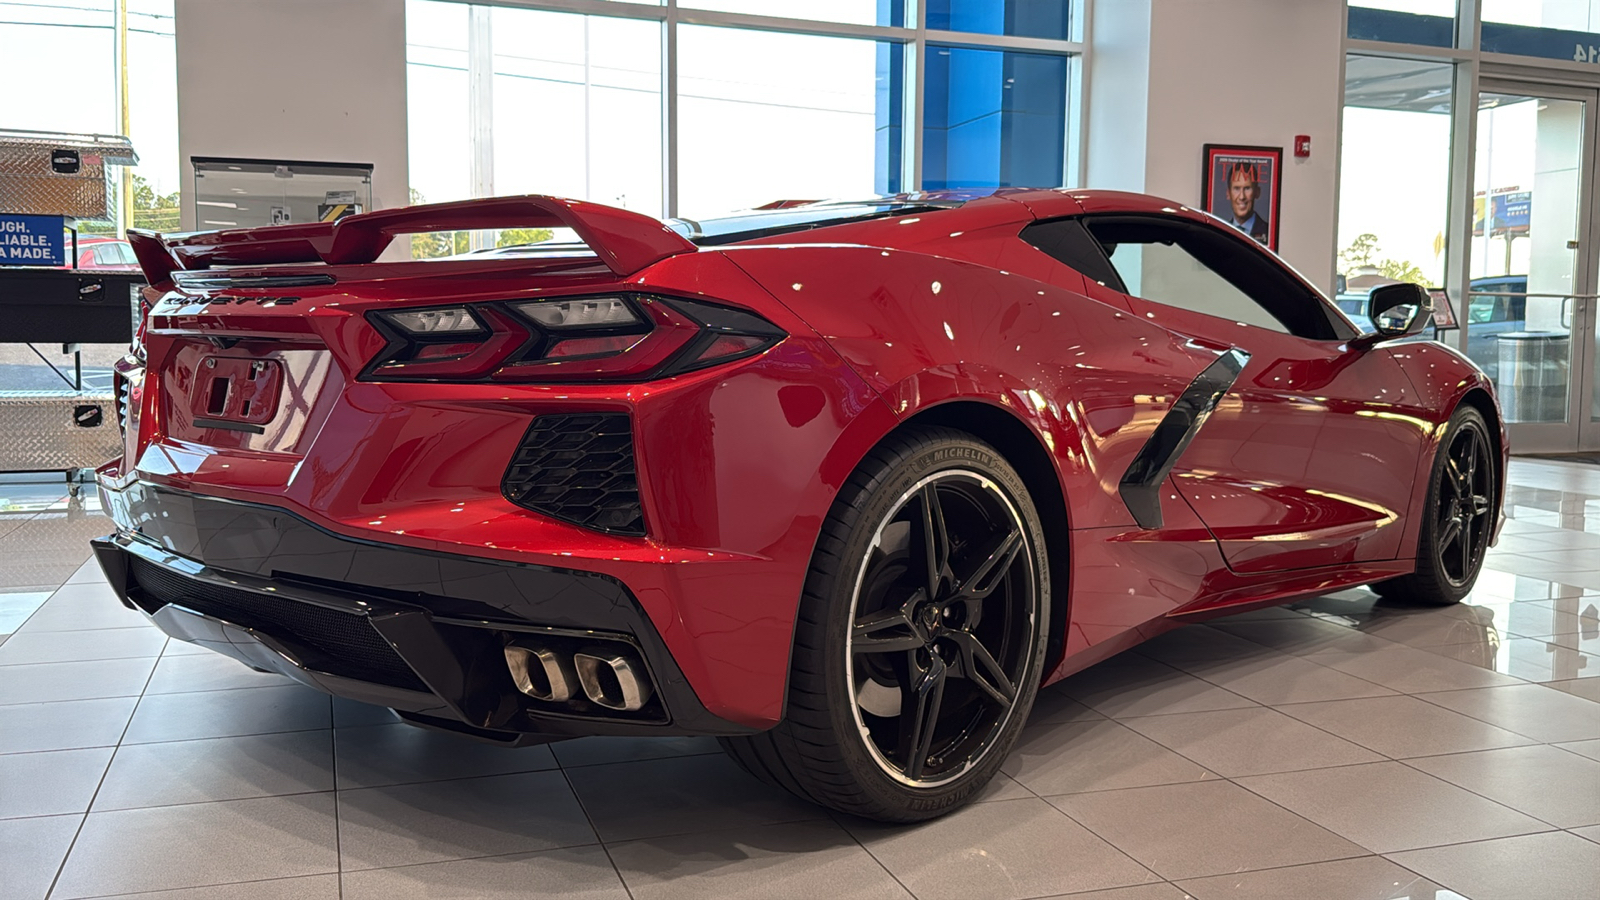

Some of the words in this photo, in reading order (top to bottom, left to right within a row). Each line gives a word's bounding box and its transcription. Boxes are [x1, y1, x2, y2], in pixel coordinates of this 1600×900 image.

[1218, 162, 1269, 183] TIME
[10, 247, 56, 259] MADE.
[933, 448, 989, 463] MICHELIN
[911, 787, 969, 810] MICHELIN
